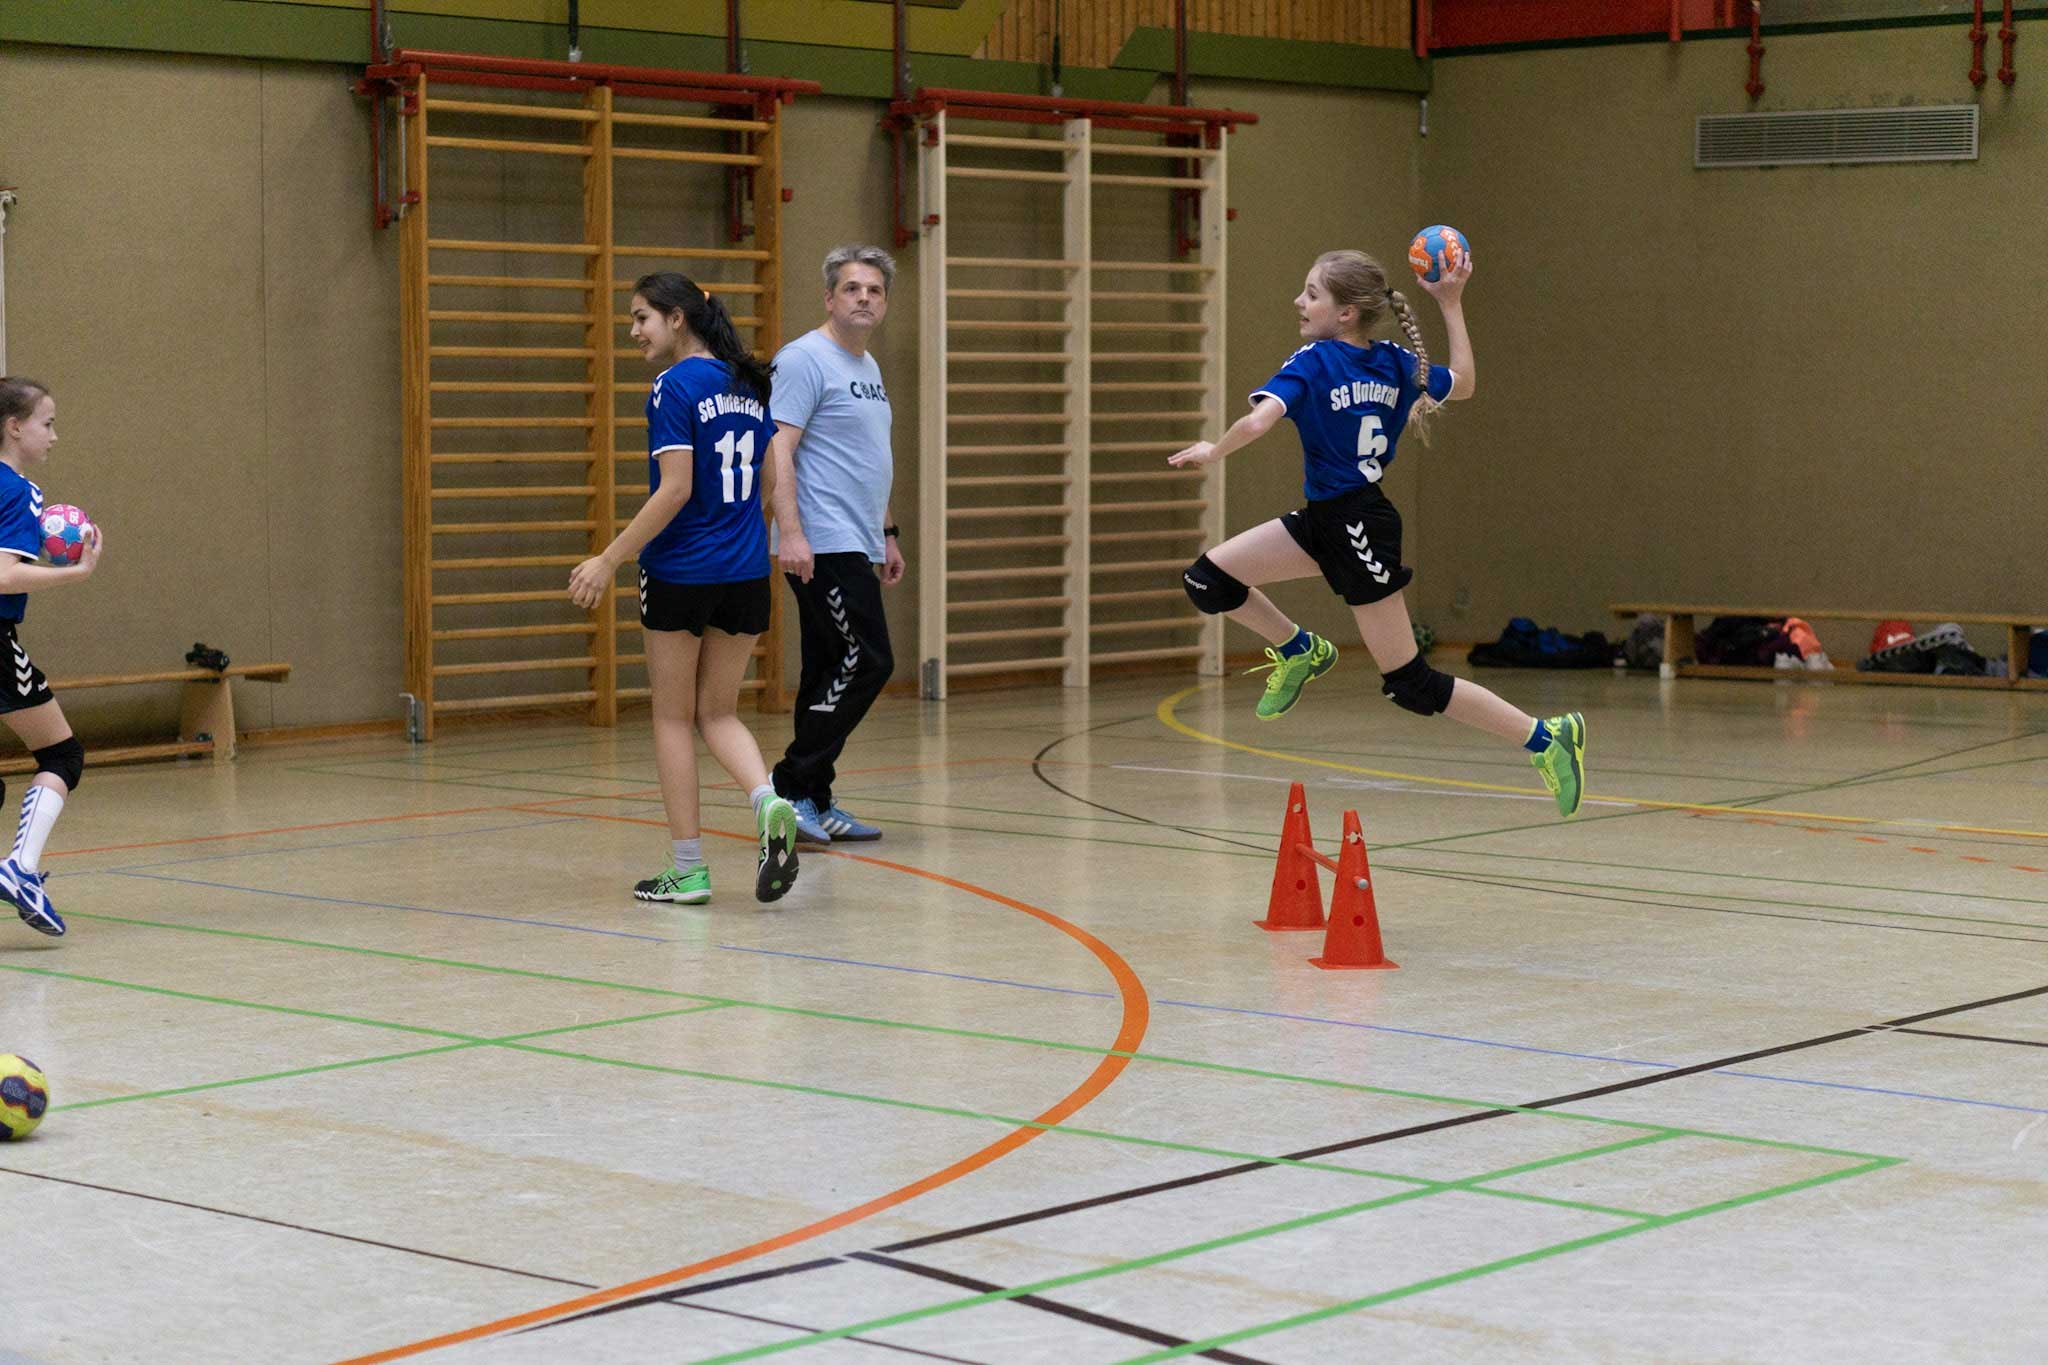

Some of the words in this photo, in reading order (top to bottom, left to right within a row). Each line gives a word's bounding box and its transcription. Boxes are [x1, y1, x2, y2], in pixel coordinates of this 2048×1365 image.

[697, 397, 717, 423] SG
[1330, 384, 1351, 411] SG
[714, 429, 755, 504] 11
[1357, 415, 1389, 484] 5
